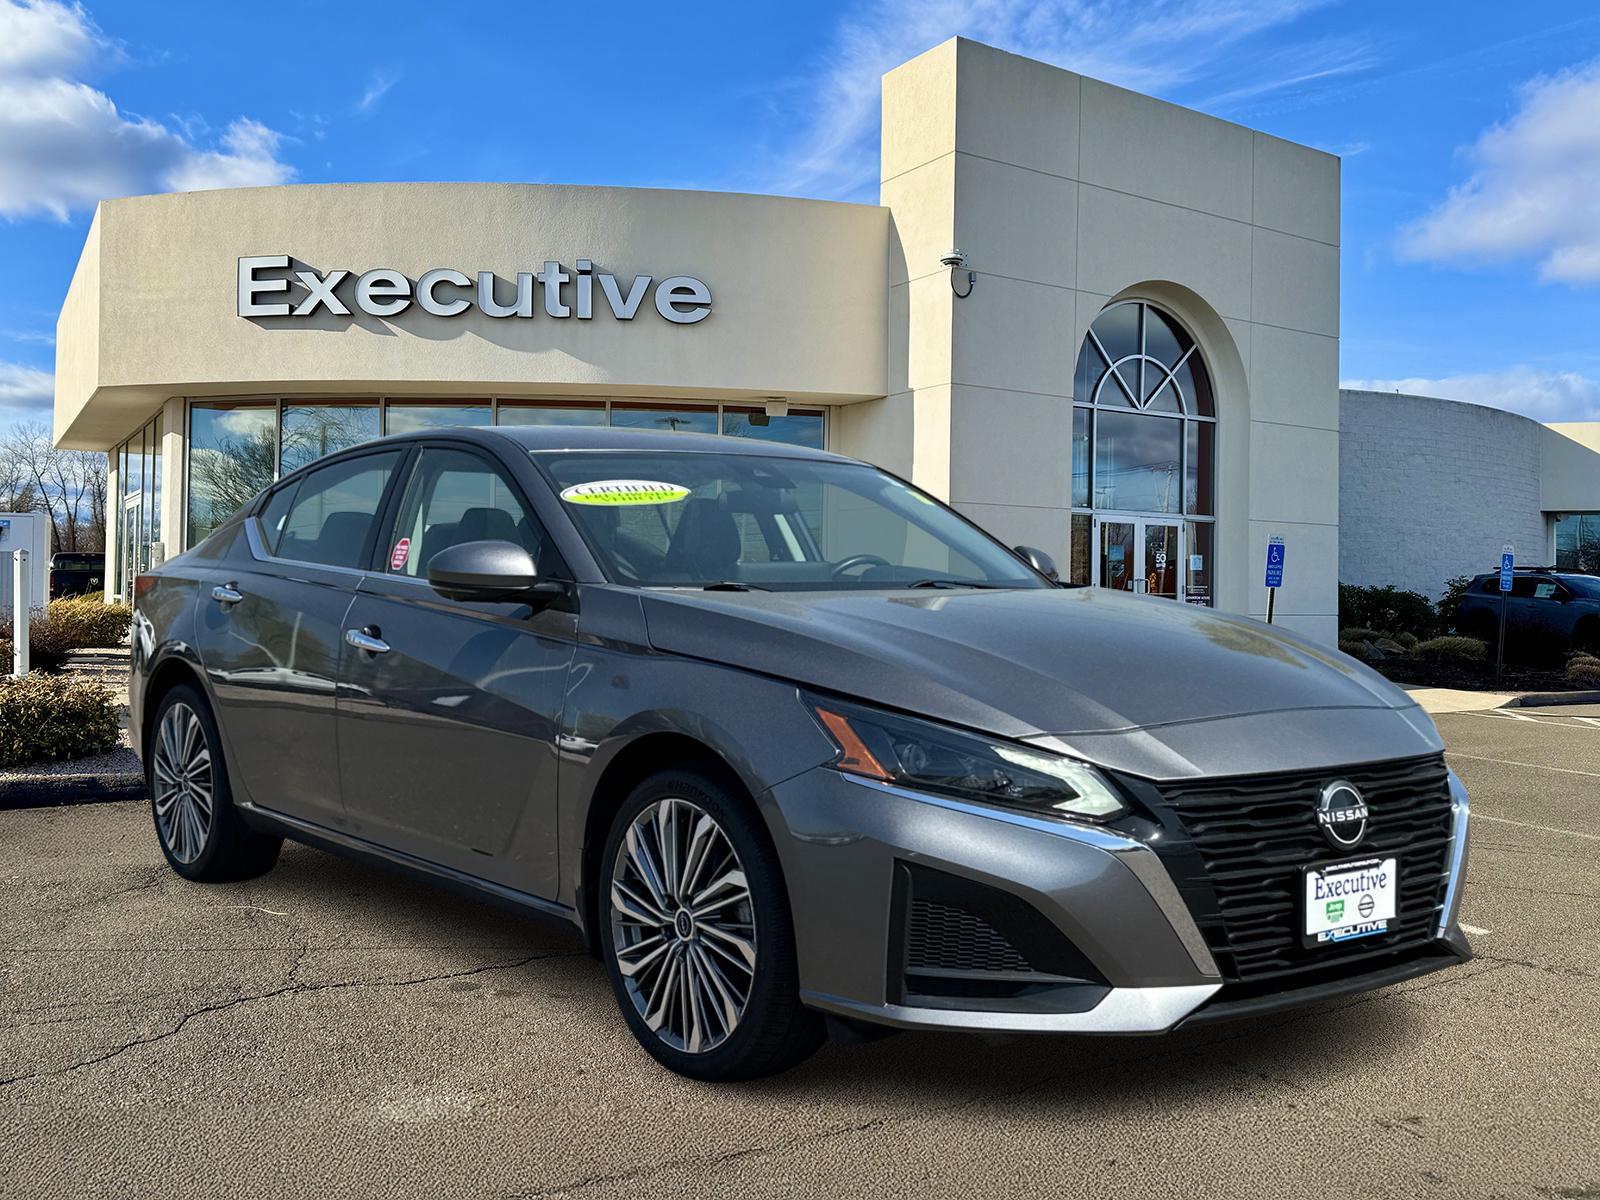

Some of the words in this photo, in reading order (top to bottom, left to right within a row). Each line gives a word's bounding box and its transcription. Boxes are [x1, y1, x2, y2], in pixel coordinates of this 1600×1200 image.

[237, 255, 713, 325] Executive
[1319, 806, 1368, 824] NISSAN
[1314, 871, 1387, 900] Executive
